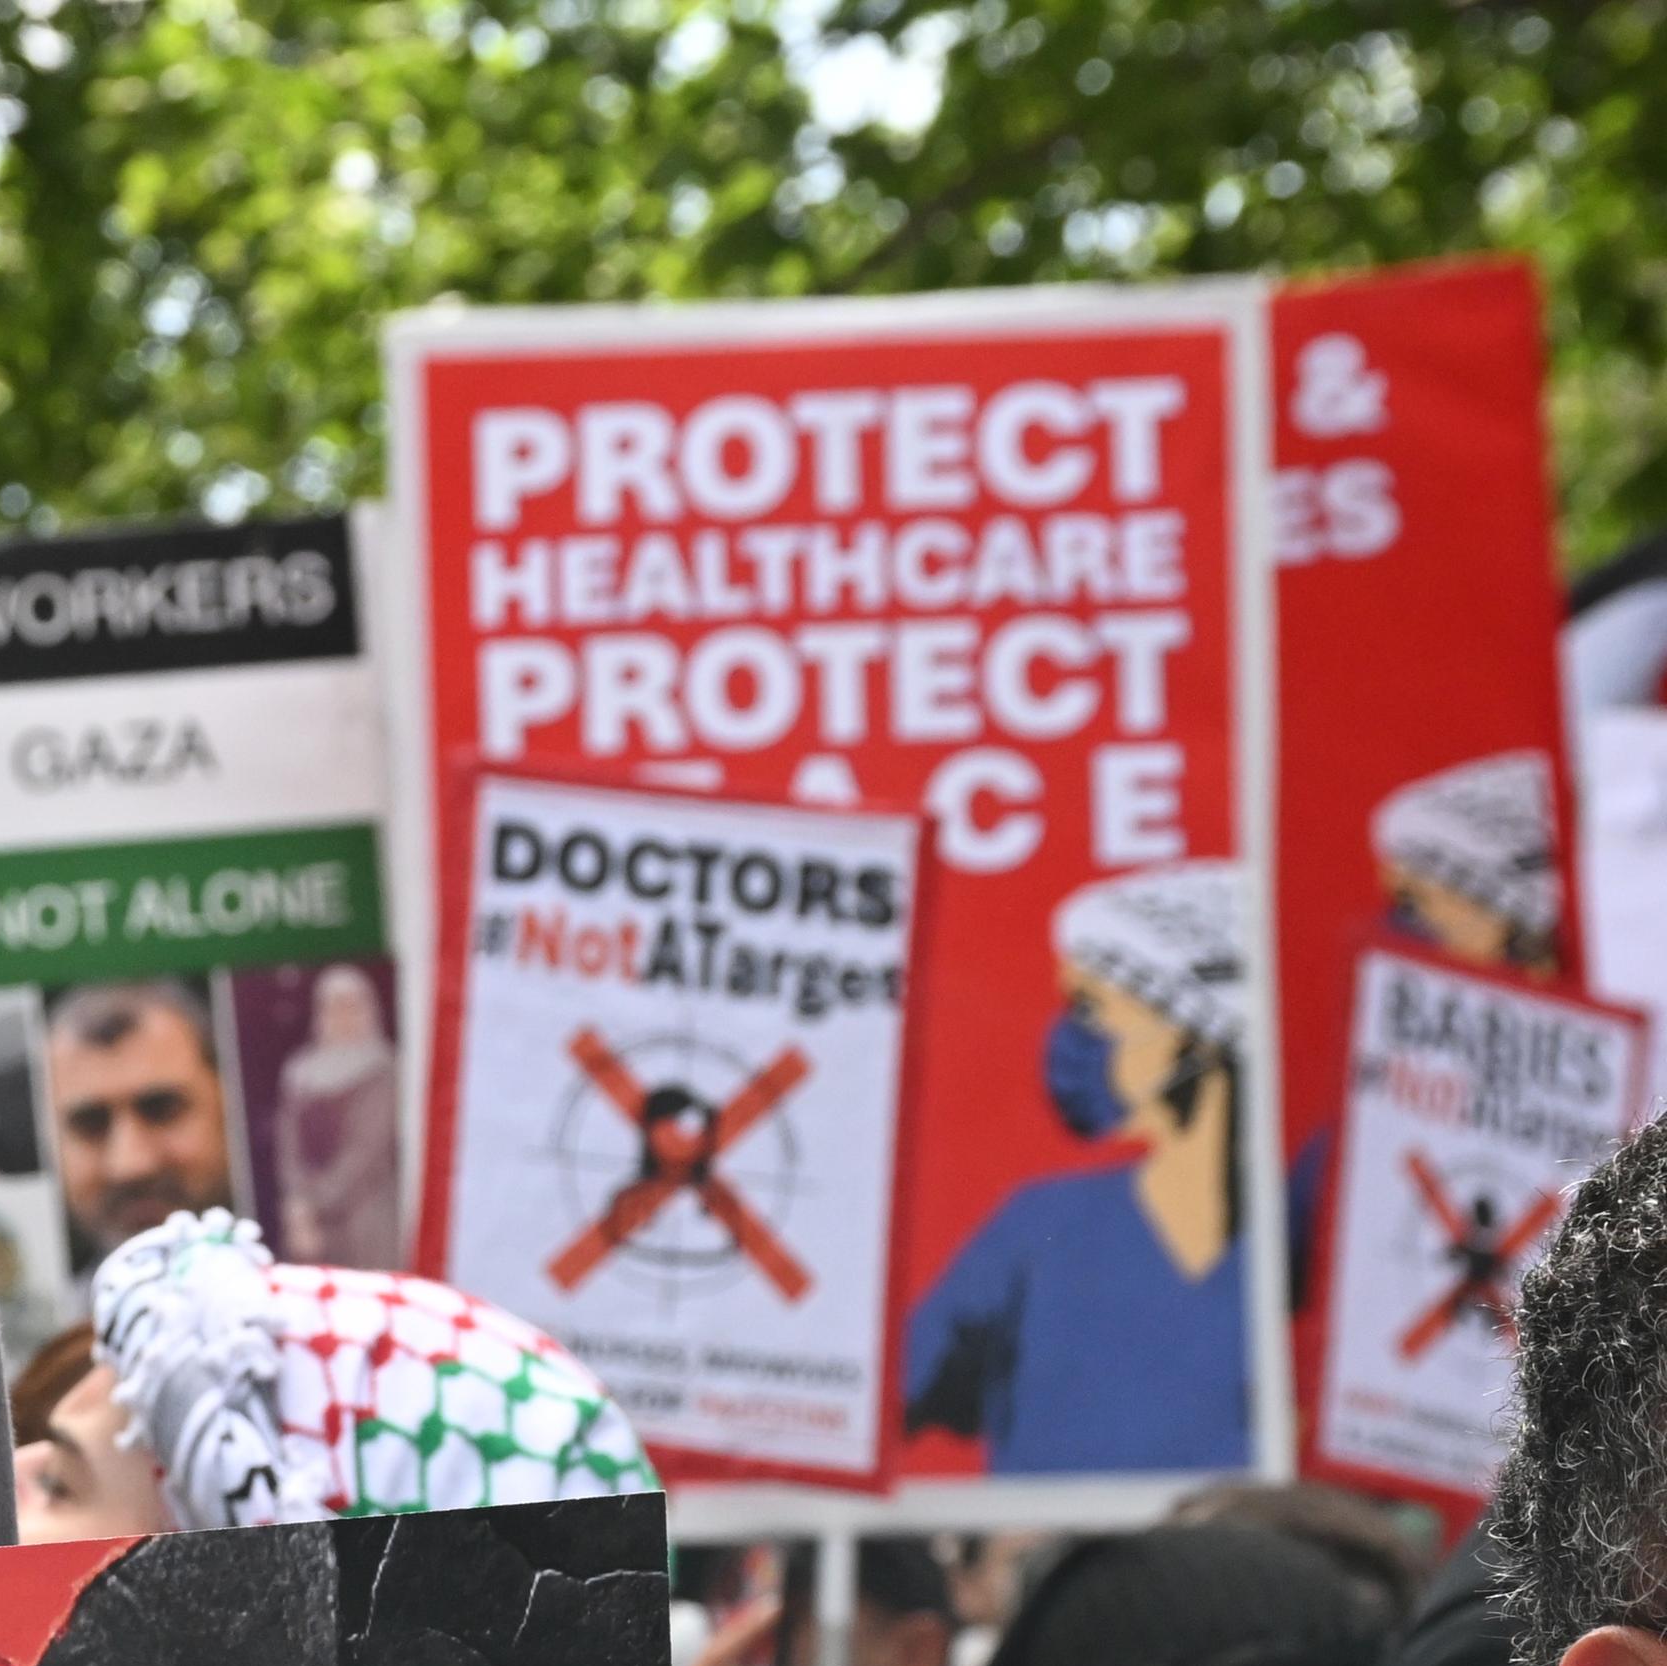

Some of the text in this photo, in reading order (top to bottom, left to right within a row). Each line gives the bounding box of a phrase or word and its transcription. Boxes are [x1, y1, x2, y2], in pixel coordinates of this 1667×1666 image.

[472, 374, 1187, 532] PROTECT
[471, 507, 1189, 628] HEALTHCARE
[476, 610, 1193, 763] PROTECT
[9, 716, 221, 792] GAZA
[123, 859, 353, 940] ALONE
[491, 819, 897, 929] DOCTORS
